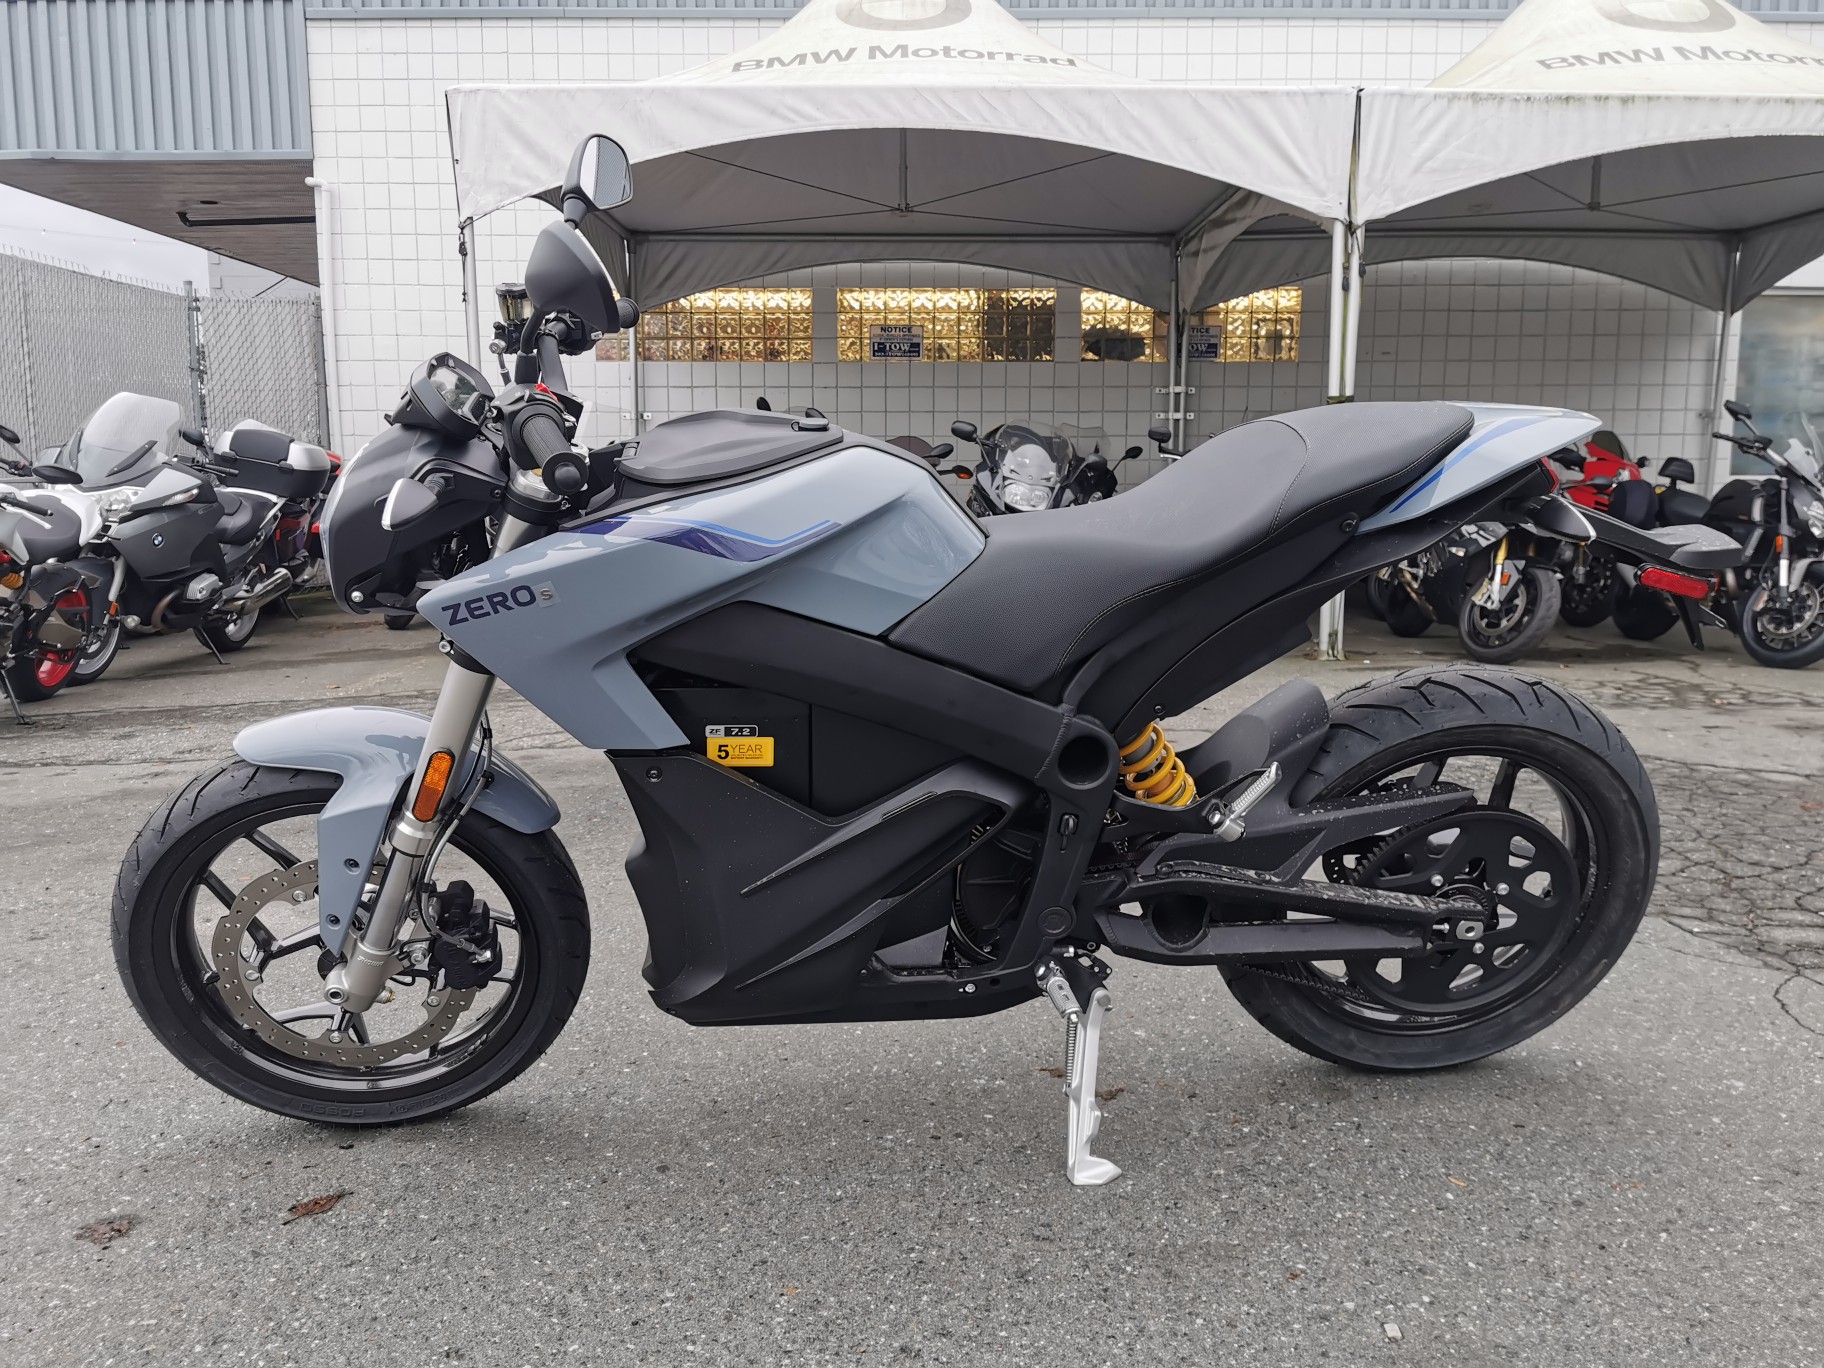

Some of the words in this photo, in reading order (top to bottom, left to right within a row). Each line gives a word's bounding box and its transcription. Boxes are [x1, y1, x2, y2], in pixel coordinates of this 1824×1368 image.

[731, 47, 858, 73] BMW
[868, 44, 1078, 68] Motorrad
[1536, 47, 1665, 70] BMW
[441, 585, 537, 626] ZERO
[717, 744, 729, 759] 5
[730, 744, 762, 753] YEAR
